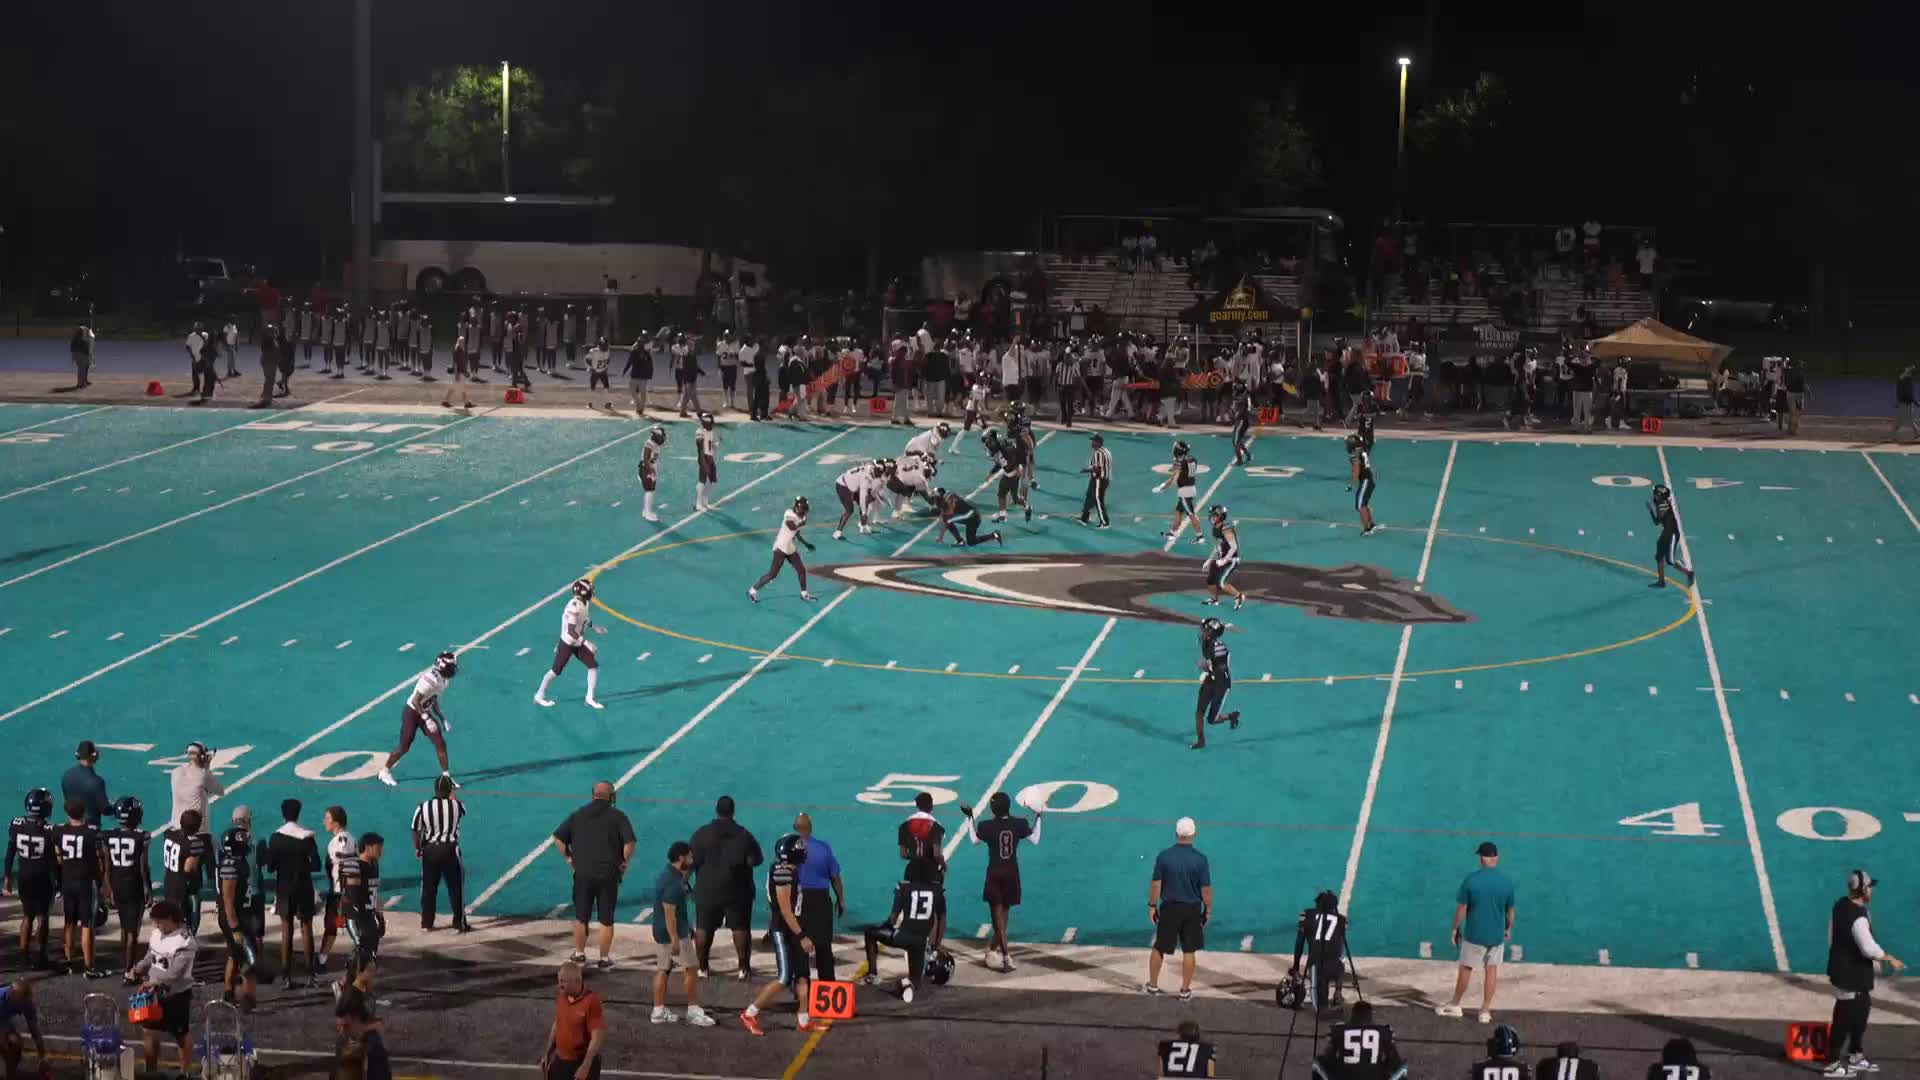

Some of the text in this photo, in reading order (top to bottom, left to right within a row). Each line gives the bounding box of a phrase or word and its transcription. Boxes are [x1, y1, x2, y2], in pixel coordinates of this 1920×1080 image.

[1210, 311, 1269, 322] goarmy.com
[1645, 418, 1658, 431] 40
[855, 773, 1120, 813] 50
[1618, 802, 1882, 841] 40
[16, 833, 45, 860] 53
[61, 834, 84, 860] 51
[108, 837, 136, 867] 22
[163, 838, 181, 873] 68
[999, 830, 1014, 859] 8
[910, 890, 934, 920] 13
[1315, 914, 1338, 941] 17
[815, 985, 847, 1014] 50
[1343, 1028, 1380, 1064] 59
[1793, 1026, 1826, 1056] 40
[1167, 1042, 1200, 1072] 21
